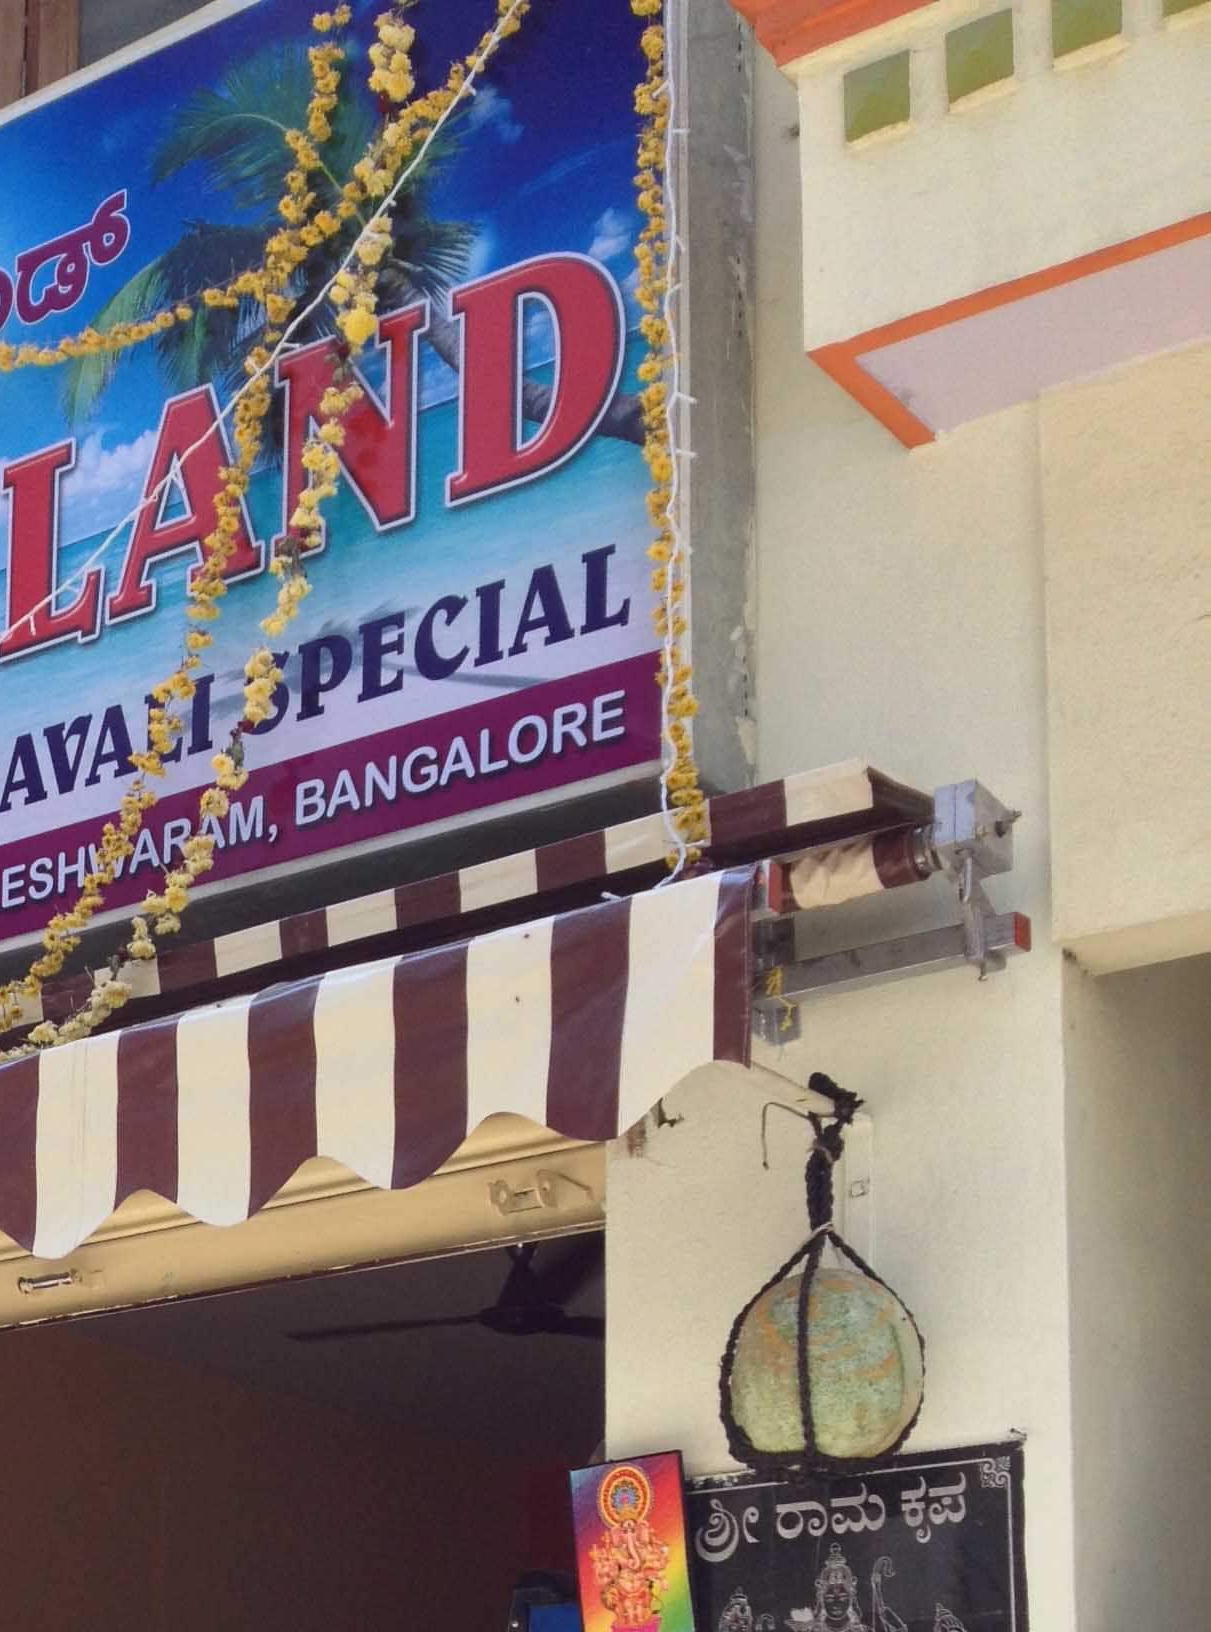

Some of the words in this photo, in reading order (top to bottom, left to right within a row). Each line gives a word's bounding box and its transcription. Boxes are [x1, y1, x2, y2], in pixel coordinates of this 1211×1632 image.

[294, 688, 627, 827] BANGALORE
[695, 1498, 760, 1563] ಶ್ರೀ
[776, 1482, 887, 1540] ರಾಮ
